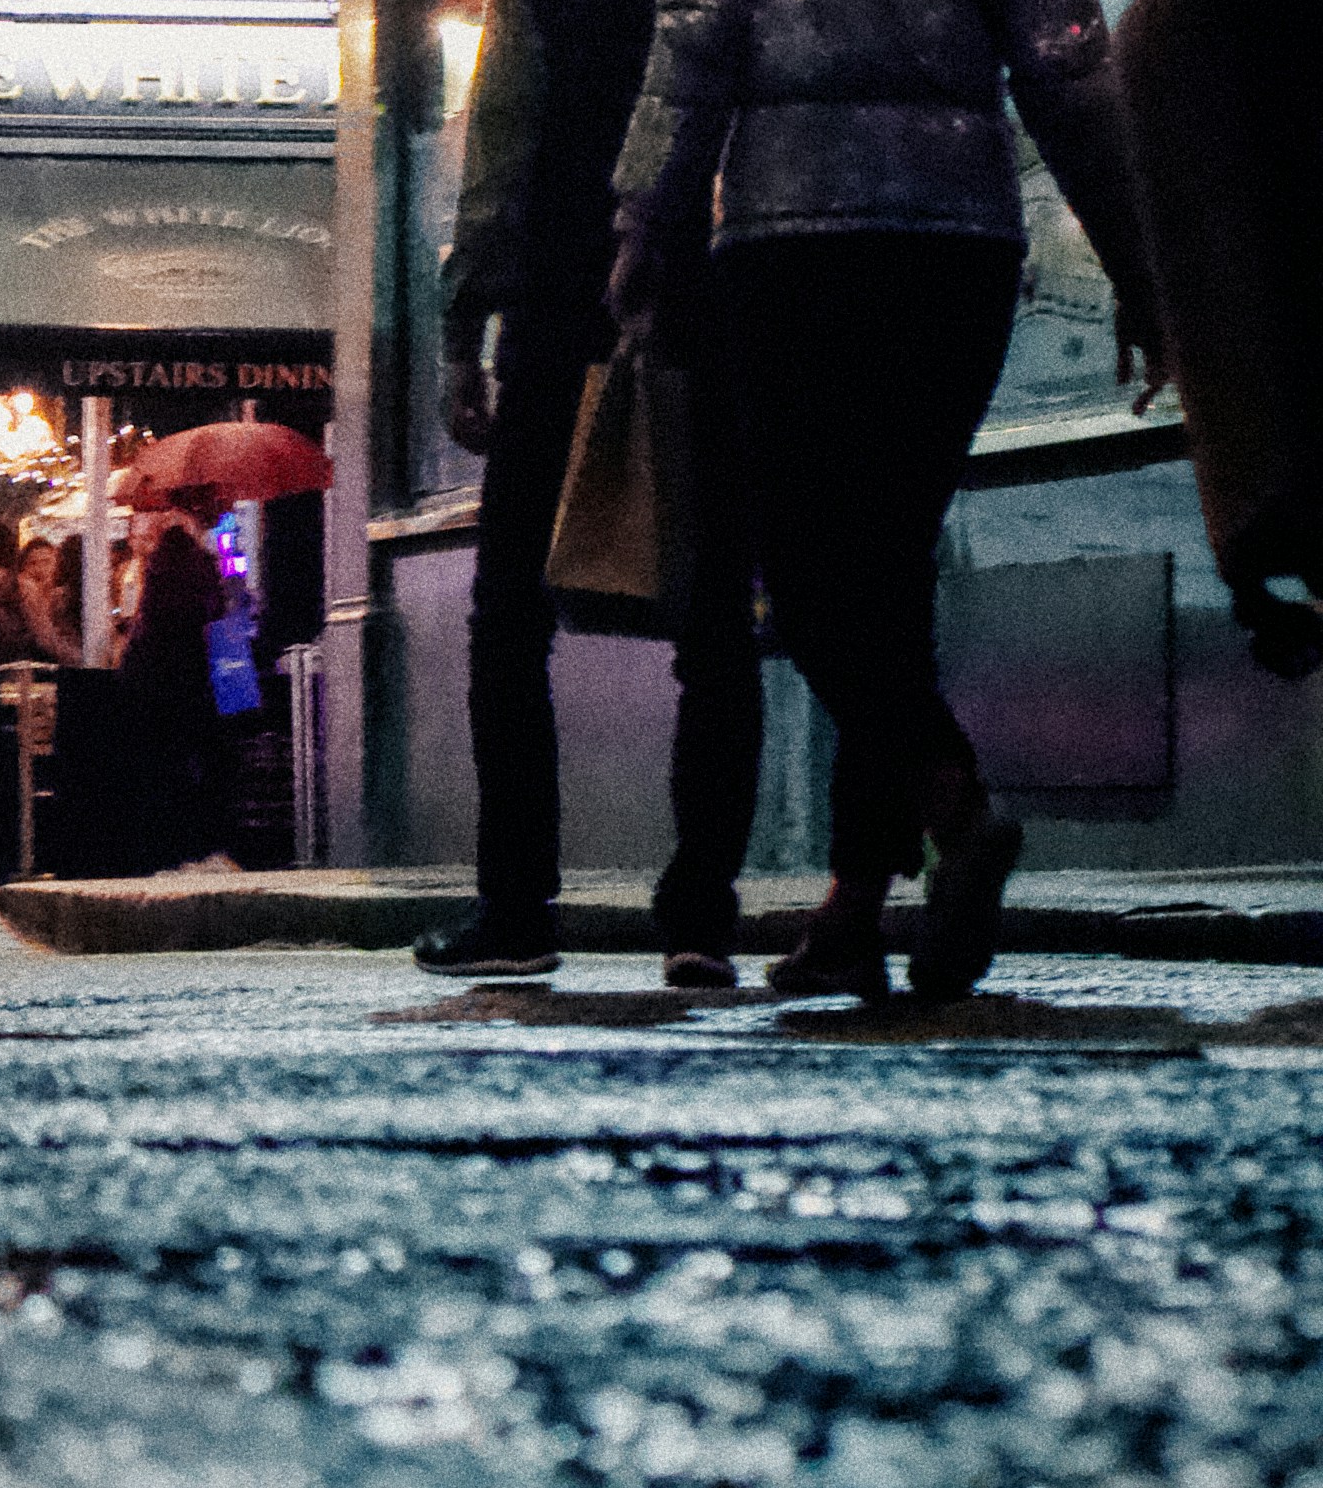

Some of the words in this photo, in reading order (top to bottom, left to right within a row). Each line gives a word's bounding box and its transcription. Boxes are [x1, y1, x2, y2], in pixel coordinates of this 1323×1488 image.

[40, 53, 309, 107] WHITE
[61, 358, 229, 388] UPSTAIRS
[236, 361, 334, 390] DININ
